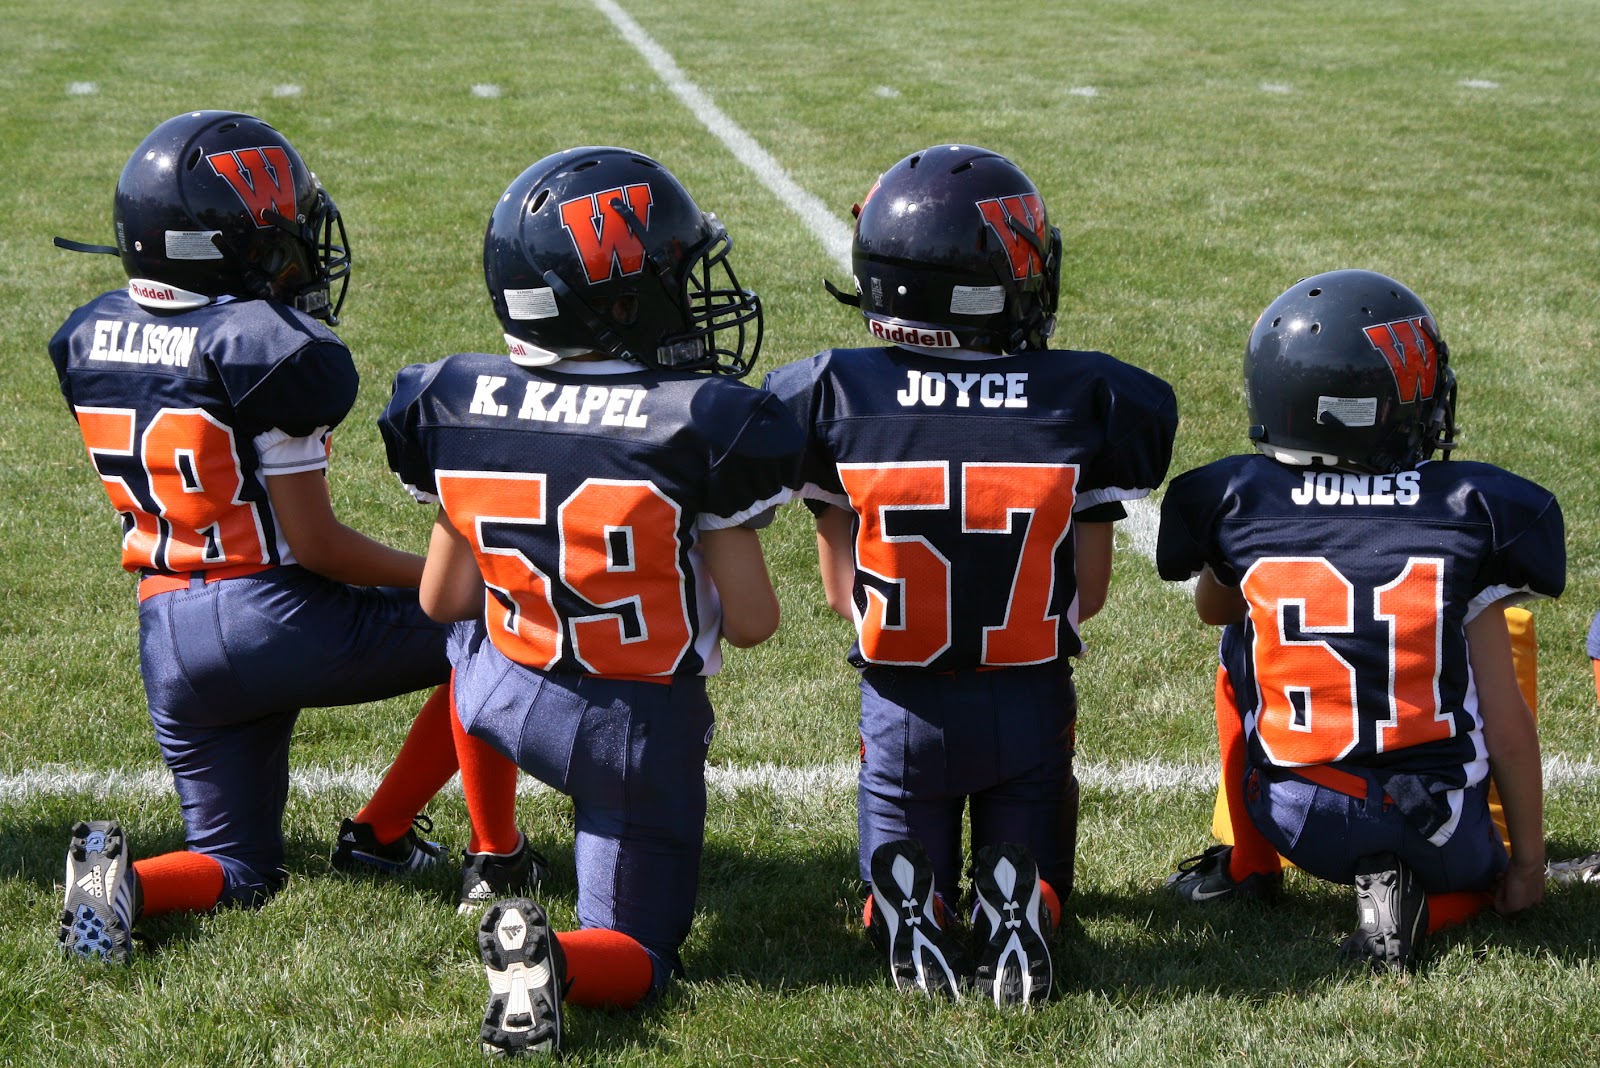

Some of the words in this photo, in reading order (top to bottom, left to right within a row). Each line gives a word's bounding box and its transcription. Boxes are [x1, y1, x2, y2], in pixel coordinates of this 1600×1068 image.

[205, 146, 297, 229] W
[559, 183, 654, 285] W
[975, 192, 1047, 281] W
[132, 283, 175, 300] Riddell
[89, 320, 199, 367] ELLISON
[872, 321, 952, 346] Riddell
[1362, 315, 1438, 404] W
[469, 375, 508, 417] K.
[517, 381, 648, 428] KAPEL
[897, 370, 1029, 408] JOYCE
[74, 405, 271, 573] 58
[1291, 471, 1421, 505] JONES
[435, 469, 693, 676] 59
[836, 460, 1080, 667] 57
[1240, 556, 1456, 768] 61
[92, 864, 103, 898] adidas
